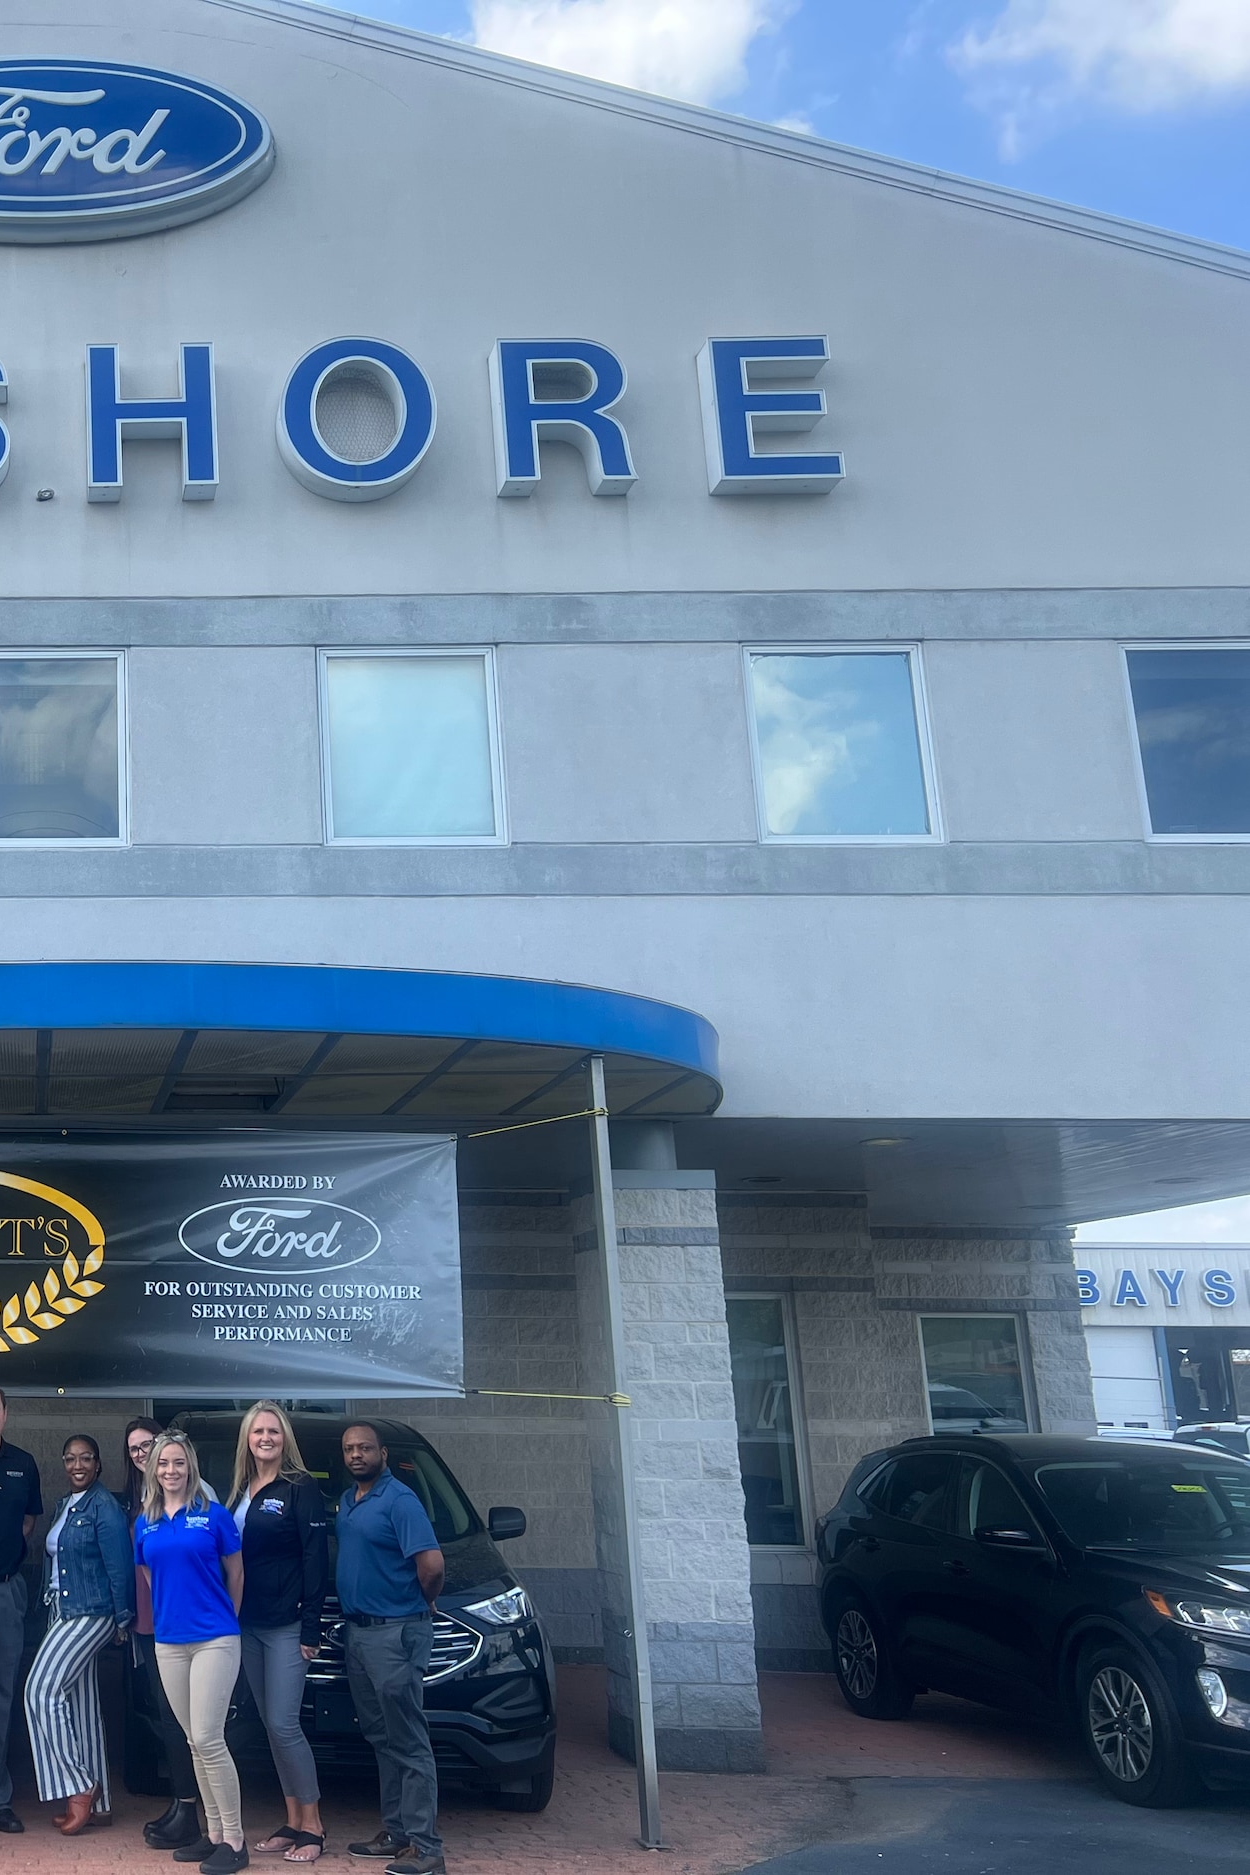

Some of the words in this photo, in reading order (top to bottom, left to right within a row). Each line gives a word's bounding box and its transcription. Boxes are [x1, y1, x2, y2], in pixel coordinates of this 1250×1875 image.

[220, 1174, 307, 1190] AWARDED
[312, 1175, 337, 1190] BY
[216, 1206, 343, 1258] Ford
[143, 1281, 182, 1297] FOR
[186, 1282, 314, 1299] OUTSTANDING
[318, 1284, 422, 1300] CUSTOMER
[1075, 1268, 1237, 1308] BAYS
[191, 1304, 269, 1320] SERVICE
[274, 1305, 312, 1320] AND
[316, 1306, 373, 1321] SALES
[213, 1326, 353, 1343] PERFORMANCE
